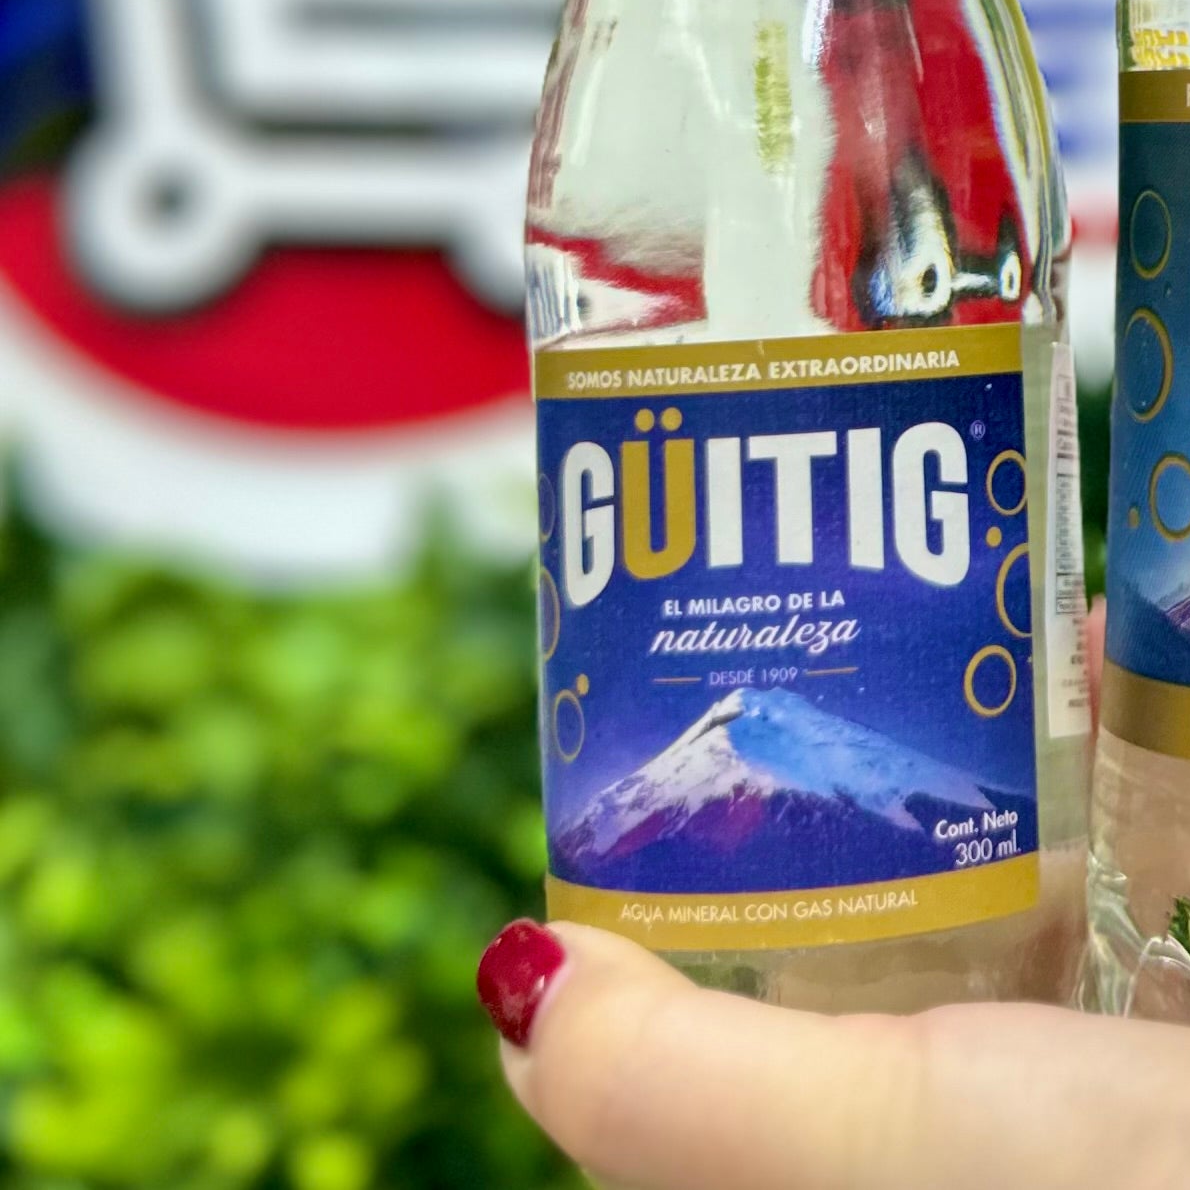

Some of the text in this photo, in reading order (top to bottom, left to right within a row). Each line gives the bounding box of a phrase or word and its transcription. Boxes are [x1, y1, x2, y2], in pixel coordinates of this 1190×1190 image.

[568, 350, 960, 390] SOMOS NATURALEZA EXTRAORDINARIA
[562, 408, 970, 606] GÜITIG
[663, 590, 845, 616] EL MILAGRO DE LA
[649, 614, 862, 653] naturaleza
[709, 666, 798, 686] DESDE 1909
[935, 809, 1019, 839] Cont. Neto
[955, 837, 993, 865] 300
[620, 890, 918, 922] AGUA MINERAL CON GAS NATURAL
